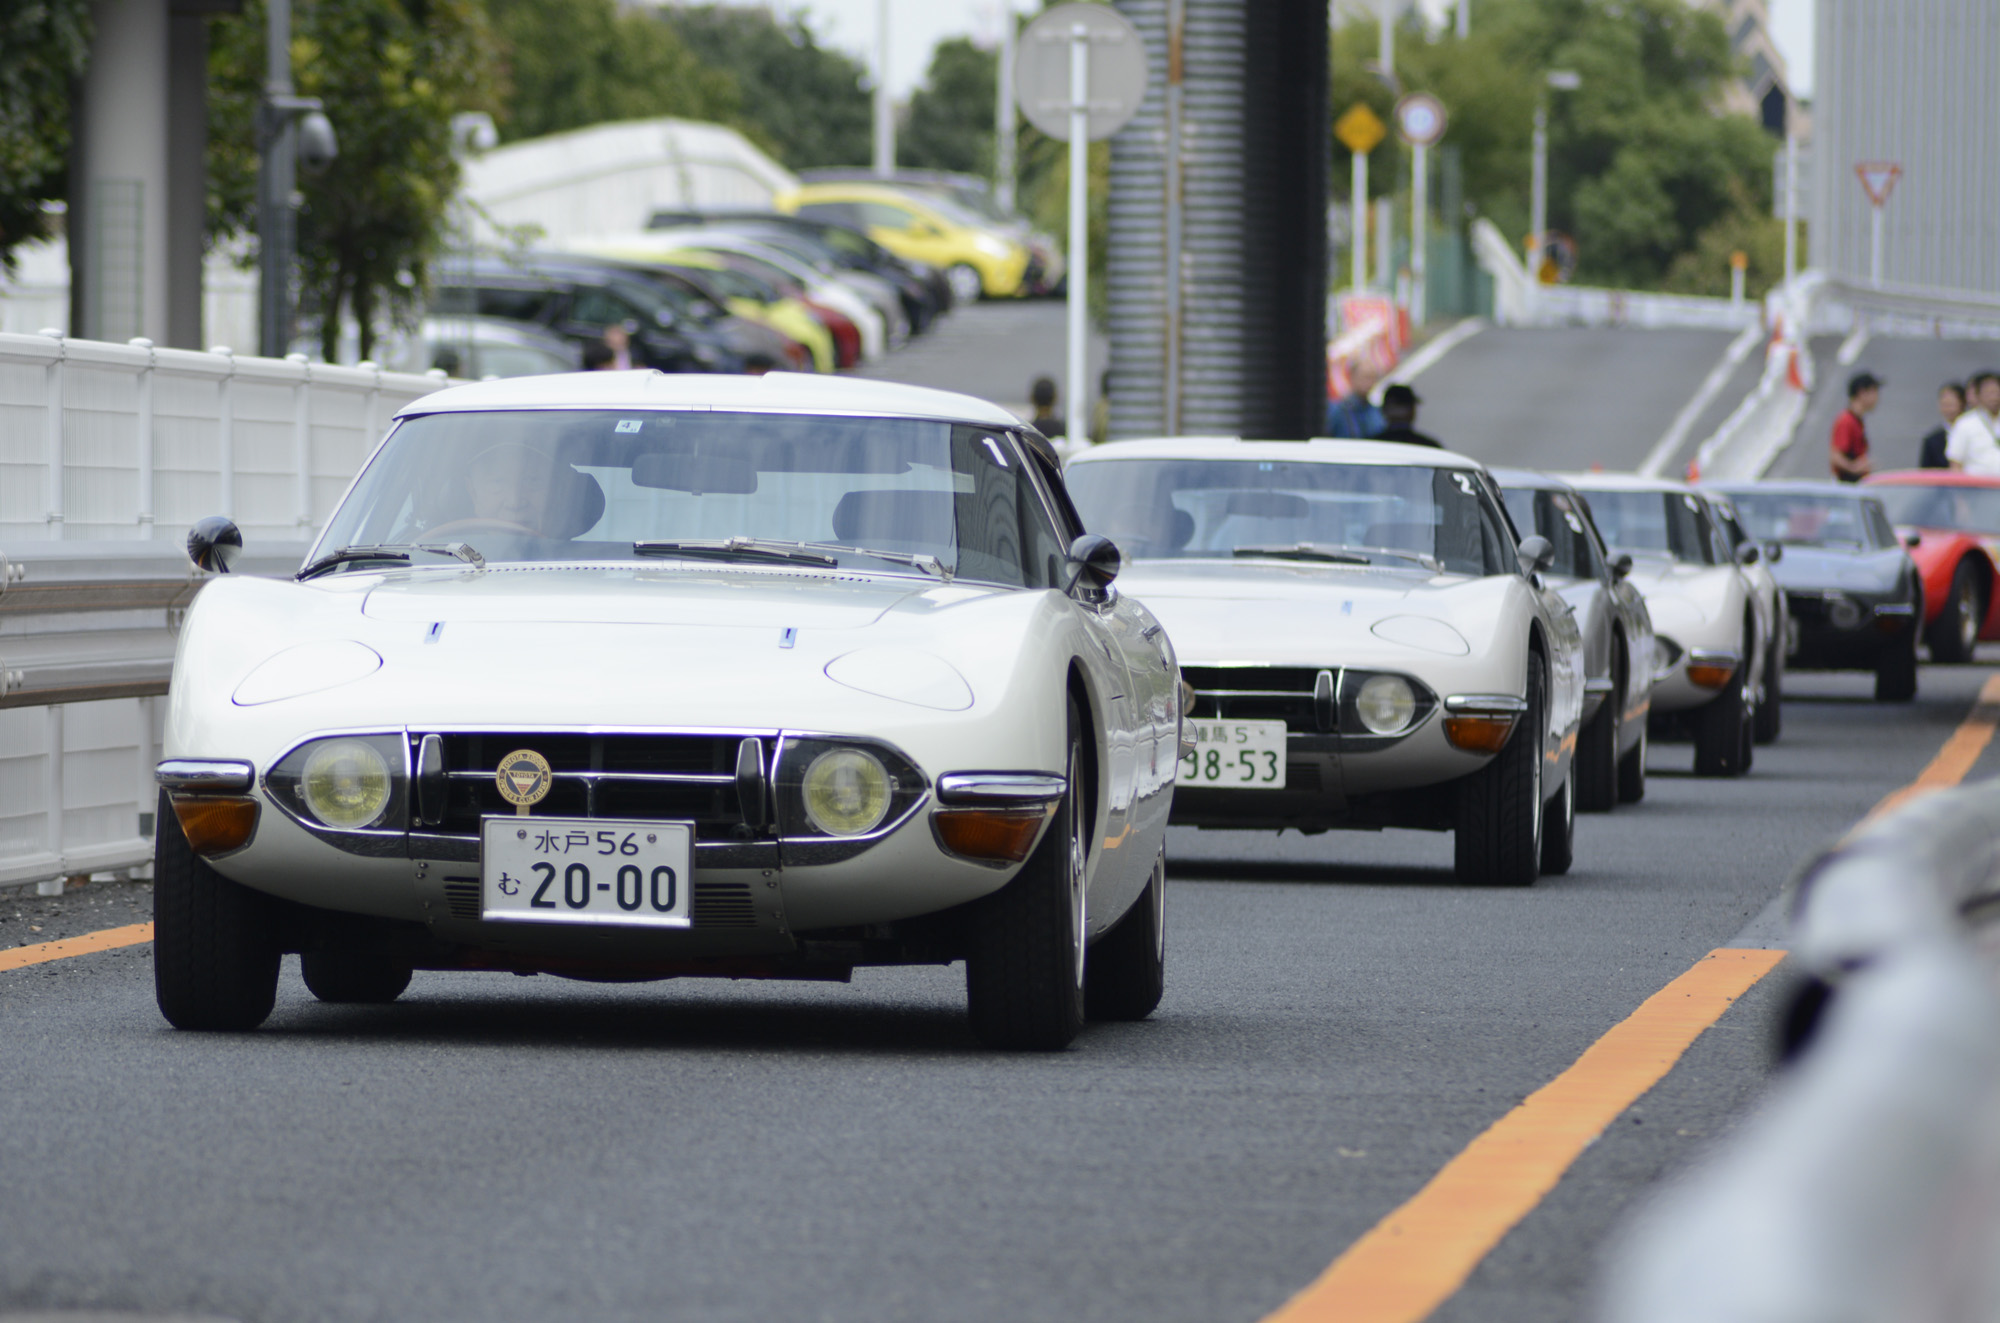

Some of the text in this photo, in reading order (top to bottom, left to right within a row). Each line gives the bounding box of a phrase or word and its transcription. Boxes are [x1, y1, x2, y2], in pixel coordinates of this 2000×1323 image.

[982, 437, 1008, 467] 1
[1453, 472, 1476, 496] 2
[1184, 749, 1278, 782] 98-53
[498, 861, 677, 913] む 20-00
